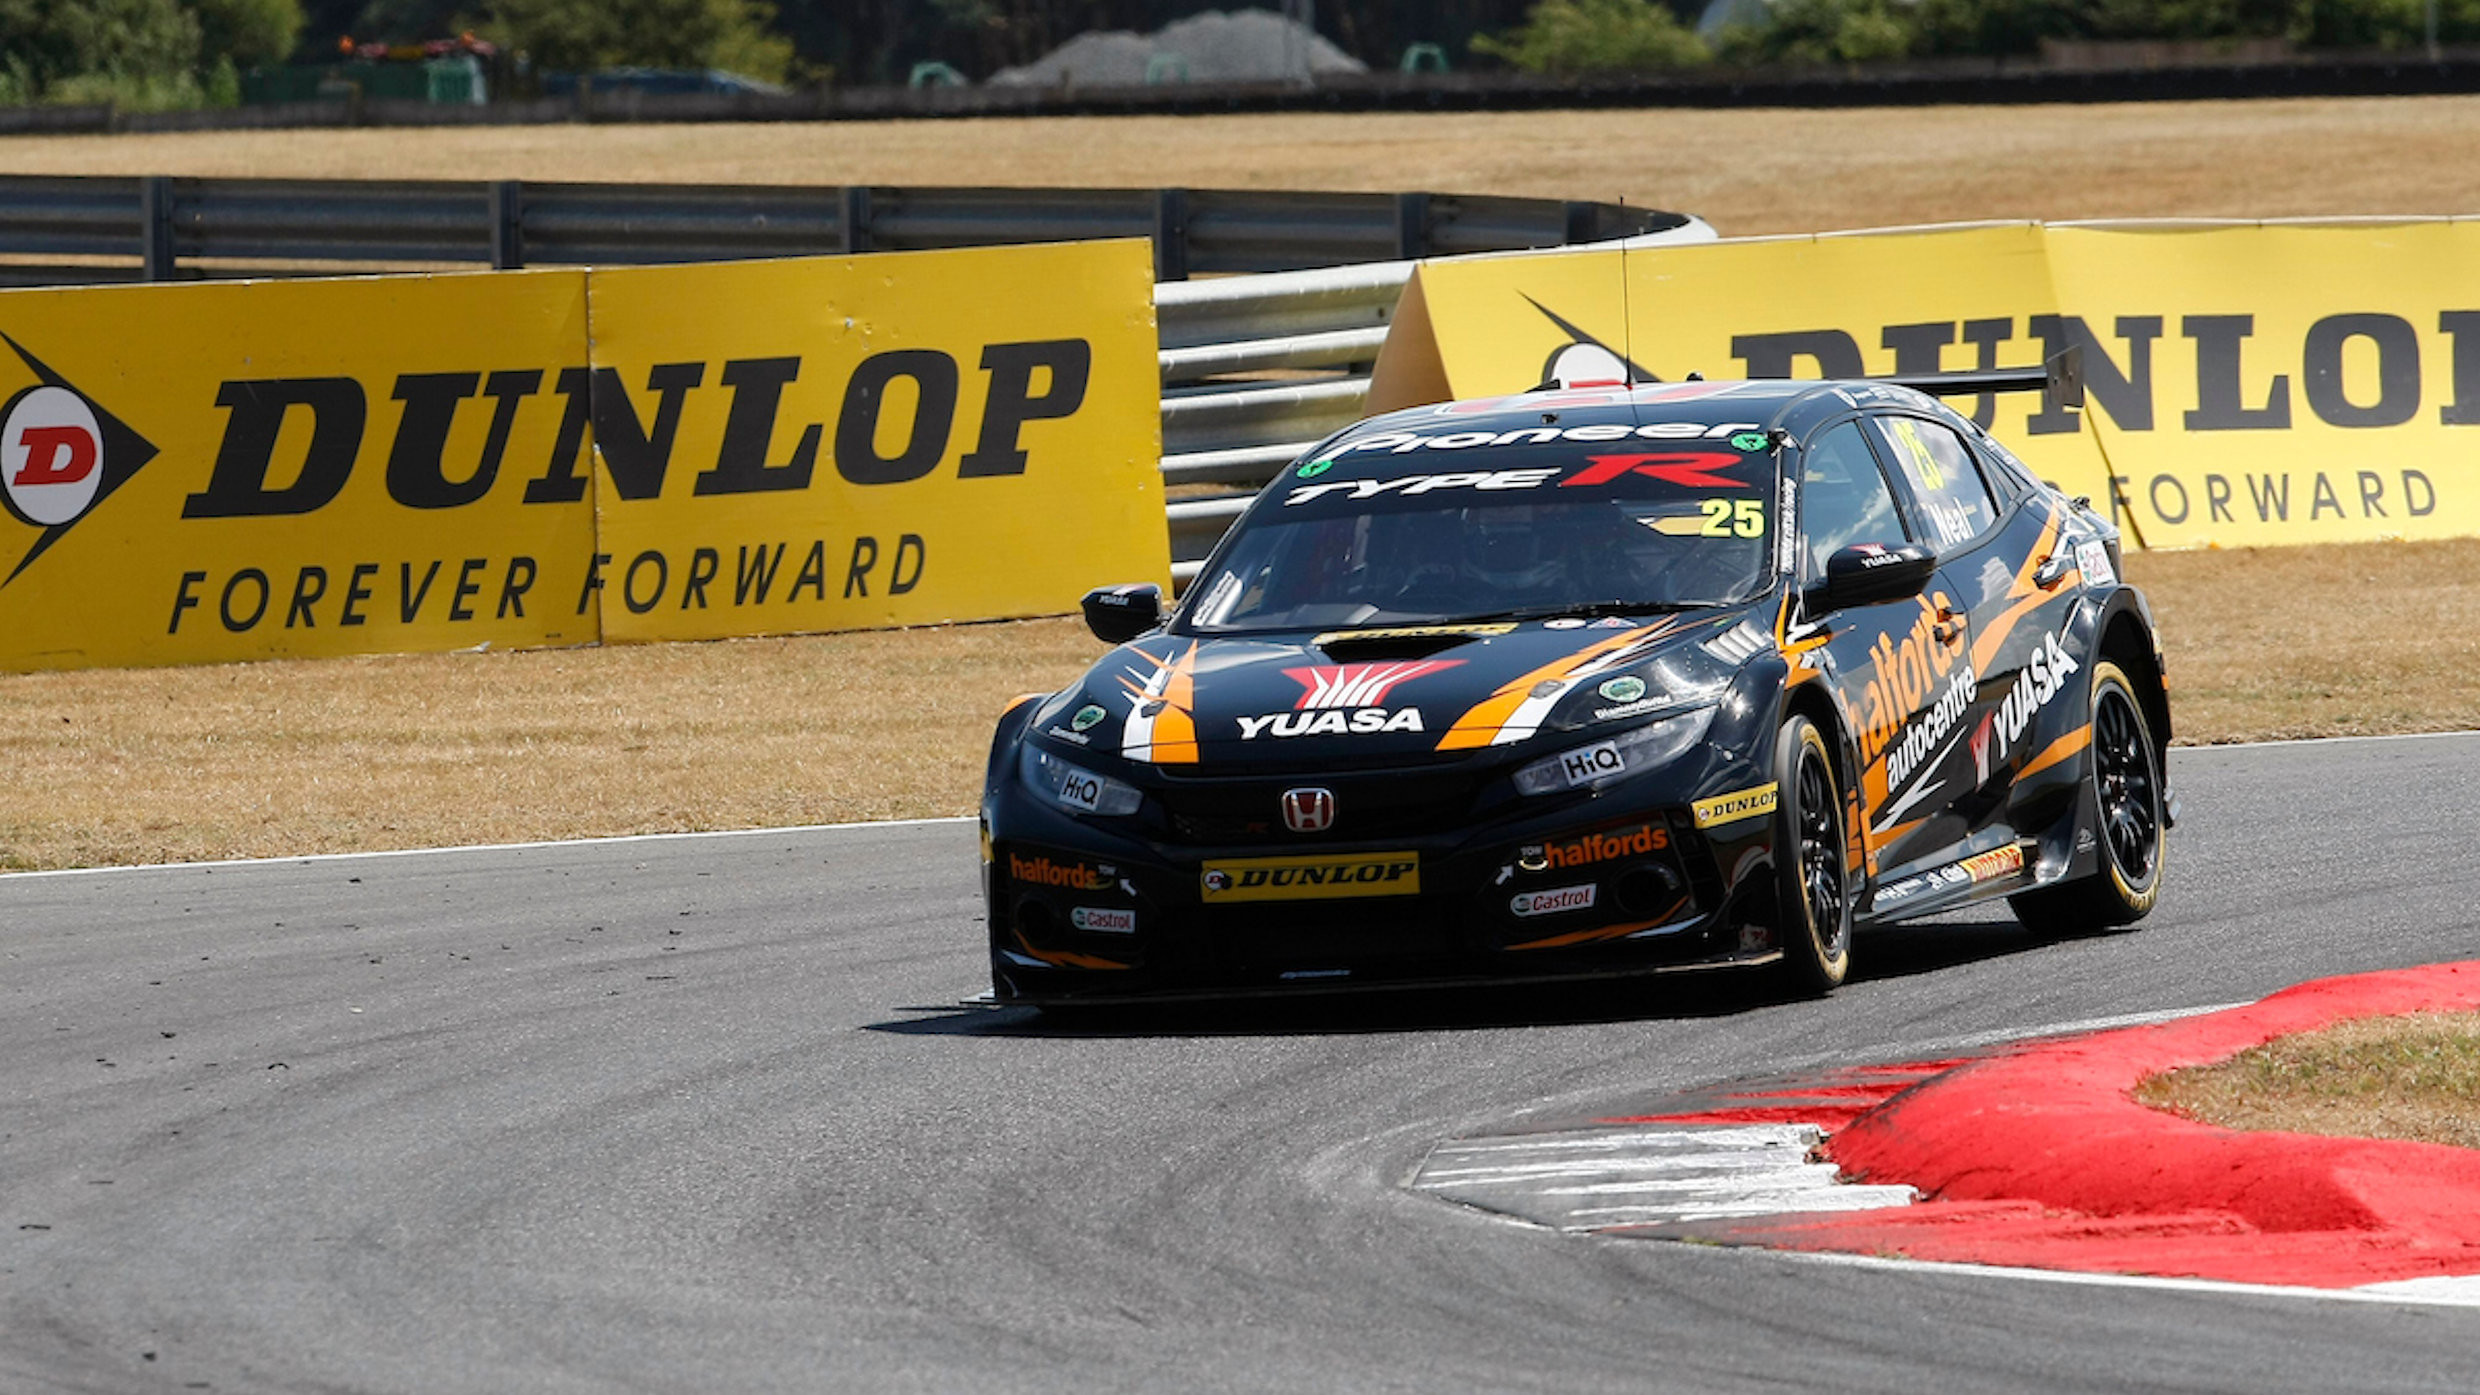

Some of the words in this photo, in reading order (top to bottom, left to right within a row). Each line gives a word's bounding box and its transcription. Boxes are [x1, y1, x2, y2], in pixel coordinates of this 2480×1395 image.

[181, 338, 1091, 519] DUNLOP
[1310, 423, 1759, 463] Pioneer
[13, 427, 96, 486] D
[1284, 467, 1562, 506] TYPE
[1562, 452, 1751, 488] R
[2109, 469, 2436, 526] FORWARD
[1699, 499, 1765, 537] 25
[1928, 497, 1975, 546] Neal
[1861, 554, 1903, 569] YUASA
[167, 557, 537, 635] FOREVER
[576, 534, 925, 615] FORWARD
[1993, 631, 2079, 760] YUASA
[1237, 707, 1424, 740] YUASA
[1886, 665, 1979, 793] autocentre
[1565, 748, 1620, 778] HiQ
[1064, 774, 1098, 805] HiQ
[1545, 825, 1668, 869] halfords
[1010, 853, 1097, 889] halfords
[1238, 863, 1415, 888] DUNLOP
[1533, 888, 1592, 911] Castrol
[1087, 911, 1132, 930] Castrol
